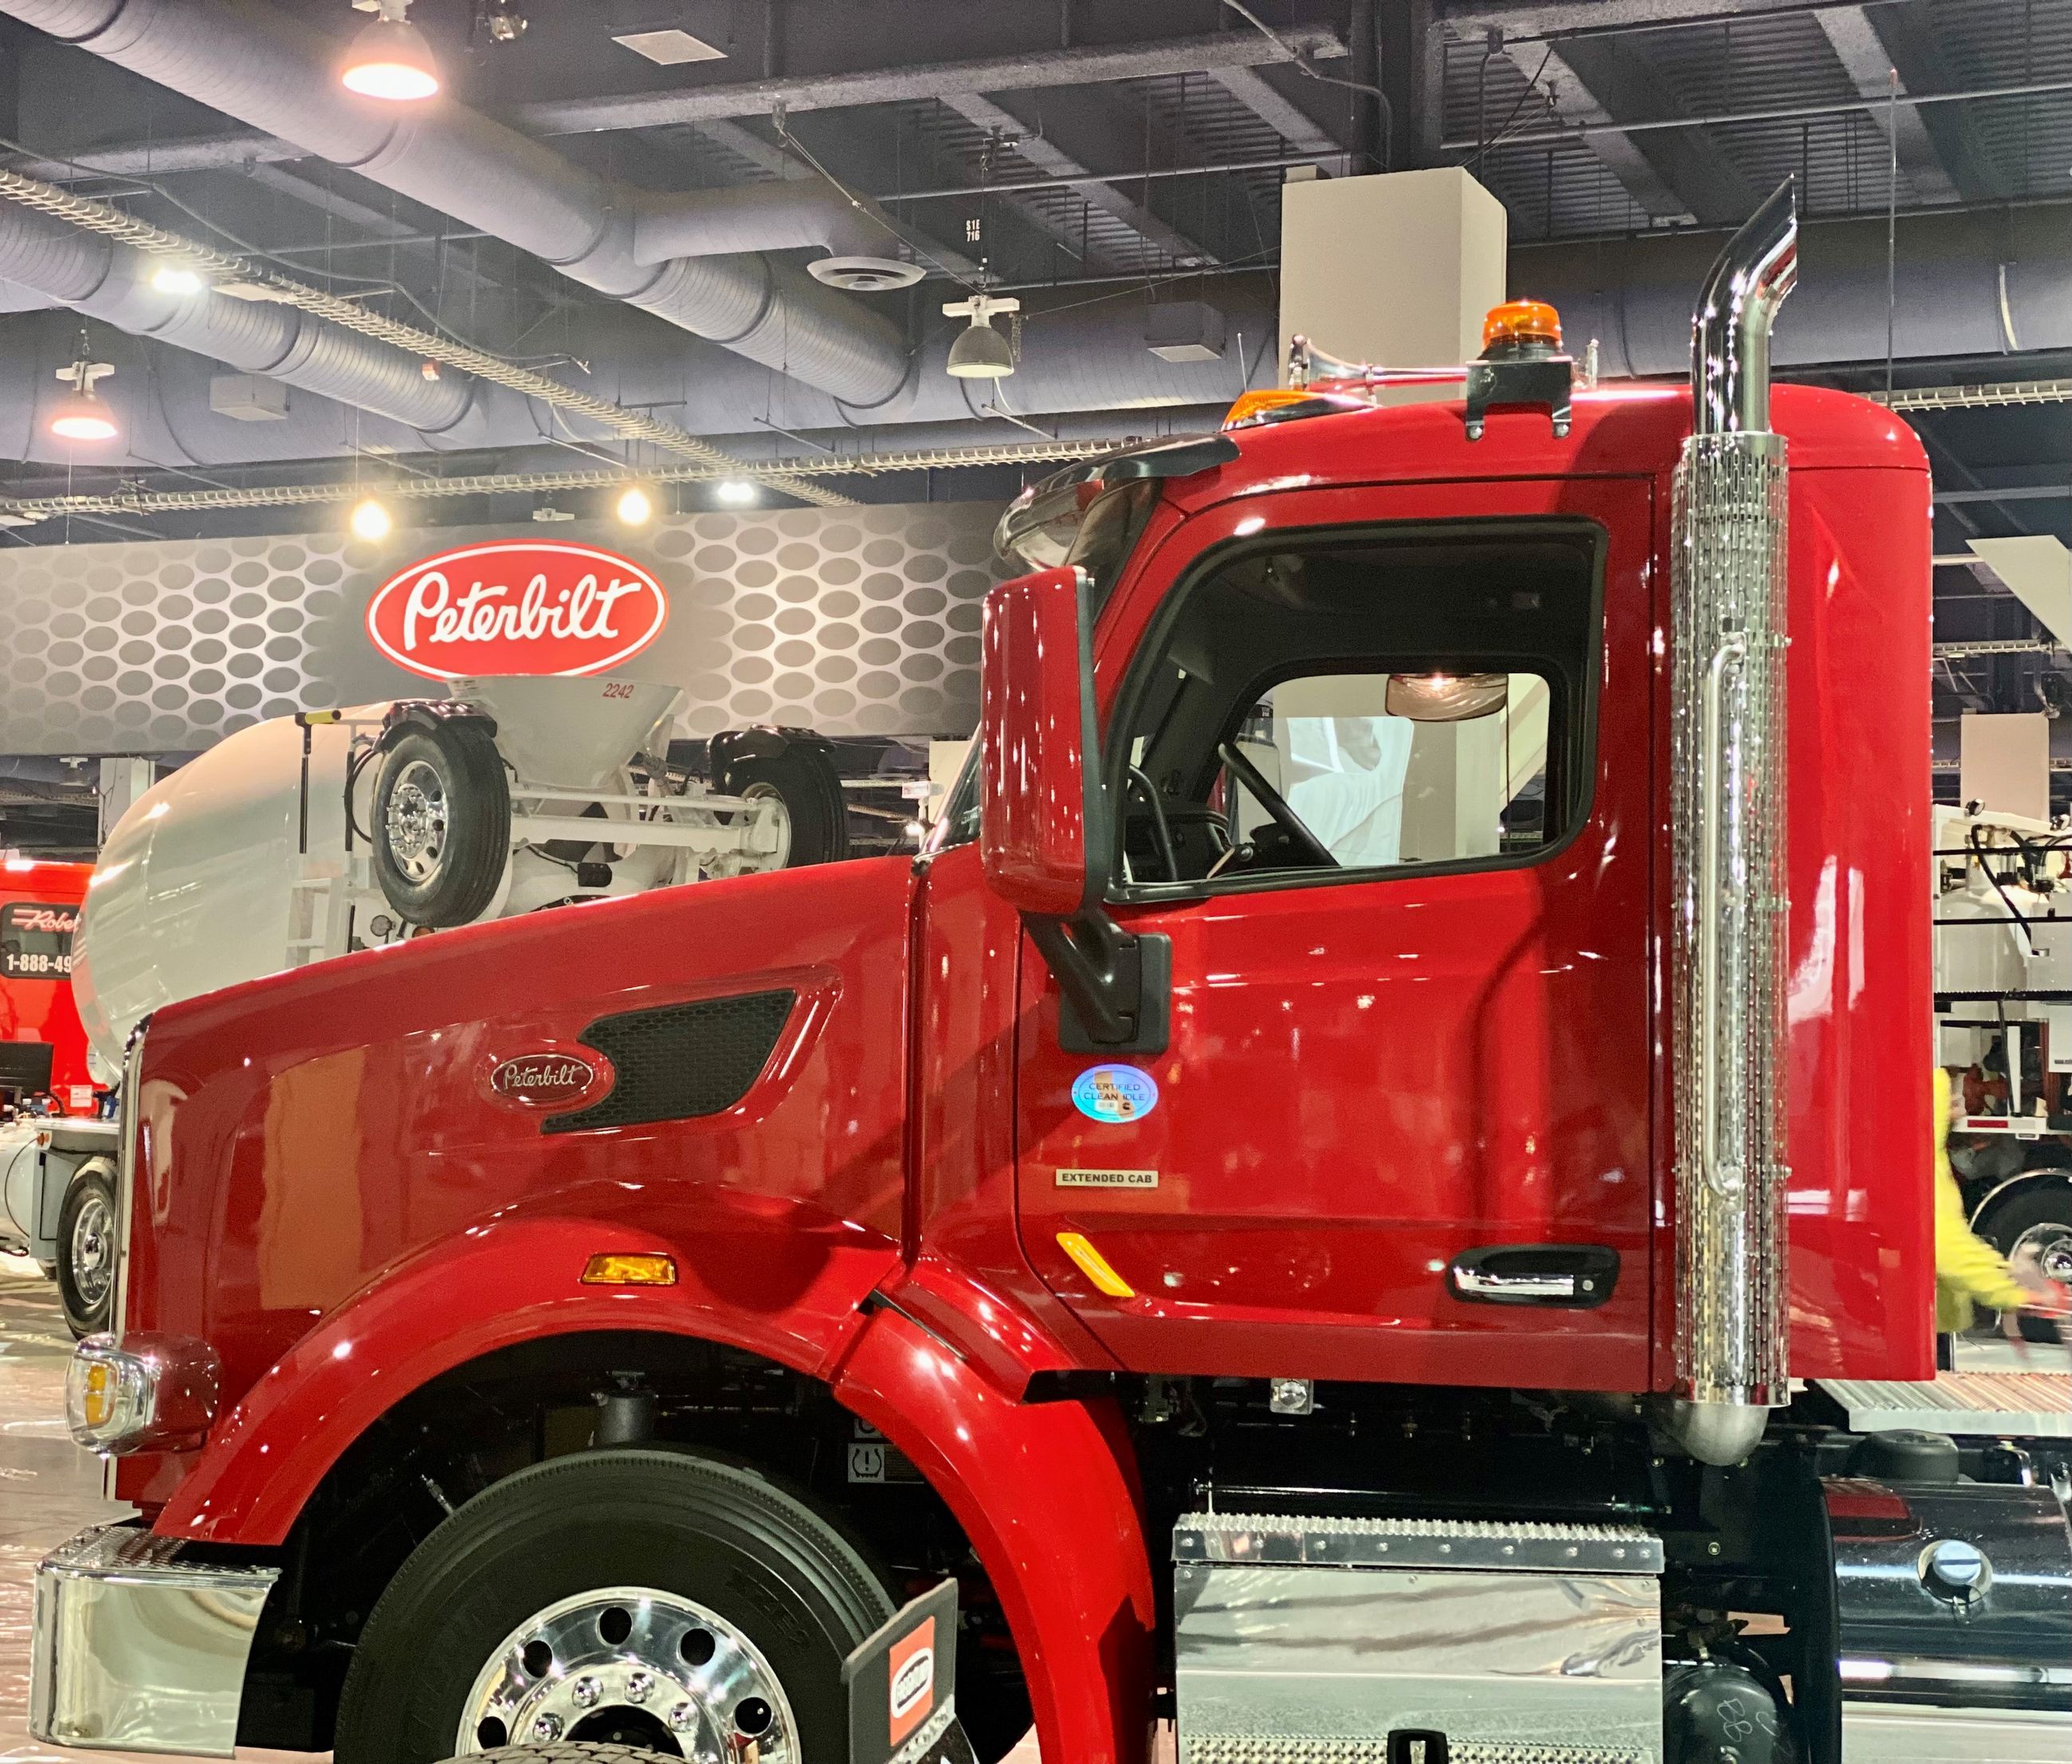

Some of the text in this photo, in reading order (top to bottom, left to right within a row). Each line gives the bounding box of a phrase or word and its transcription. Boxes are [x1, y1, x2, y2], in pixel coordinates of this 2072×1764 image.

[966, 218, 980, 231] S1E
[966, 229, 980, 242] 716
[403, 571, 642, 651] Peterbilt
[602, 683, 634, 699] 2242
[11, 908, 77, 932] Robe
[504, 1064, 583, 1090] Peterbilt
[1062, 1173, 1152, 1183] EXTENDED CAB
